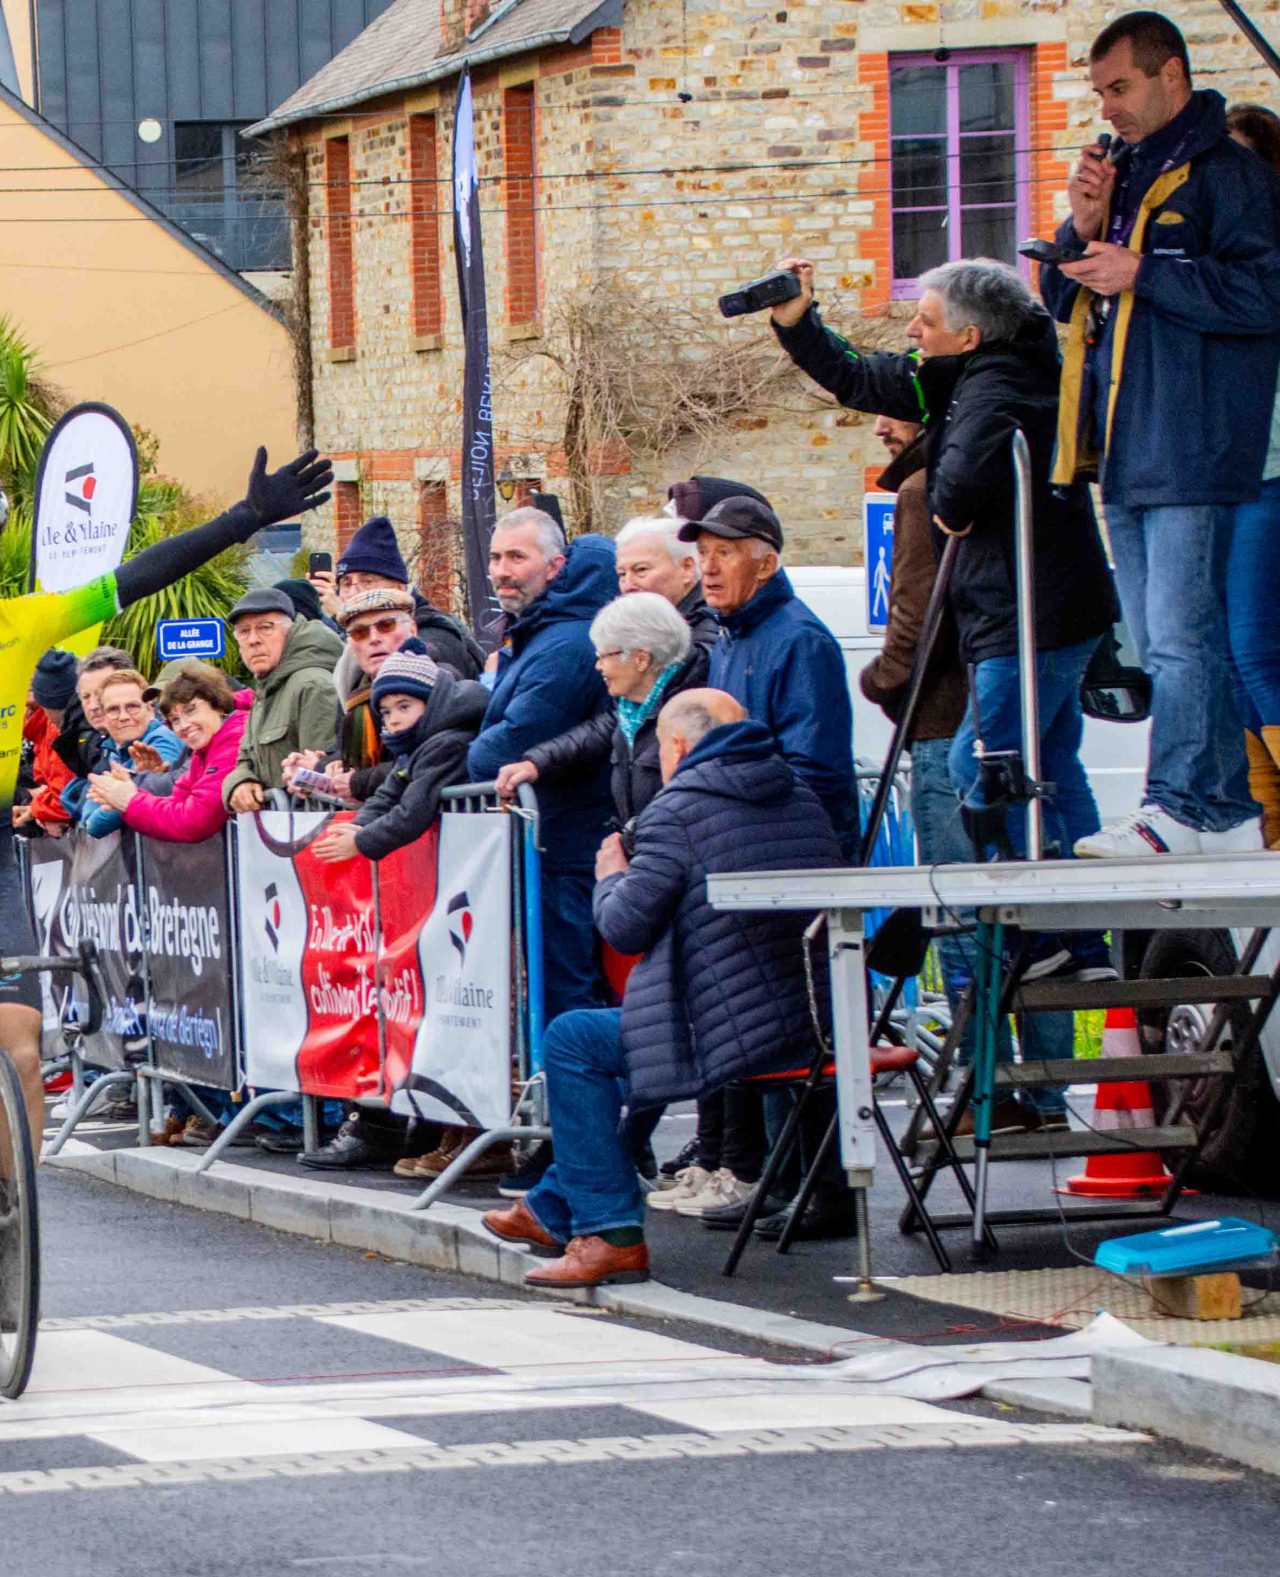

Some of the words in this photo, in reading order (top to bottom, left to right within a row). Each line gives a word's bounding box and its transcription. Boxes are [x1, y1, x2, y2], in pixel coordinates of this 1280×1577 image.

[180, 628, 200, 637] ALLÉE
[167, 641, 176, 649] DE
[177, 641, 186, 649] LA
[187, 640, 213, 649] GRANGE
[149, 887, 221, 976] Bretagne
